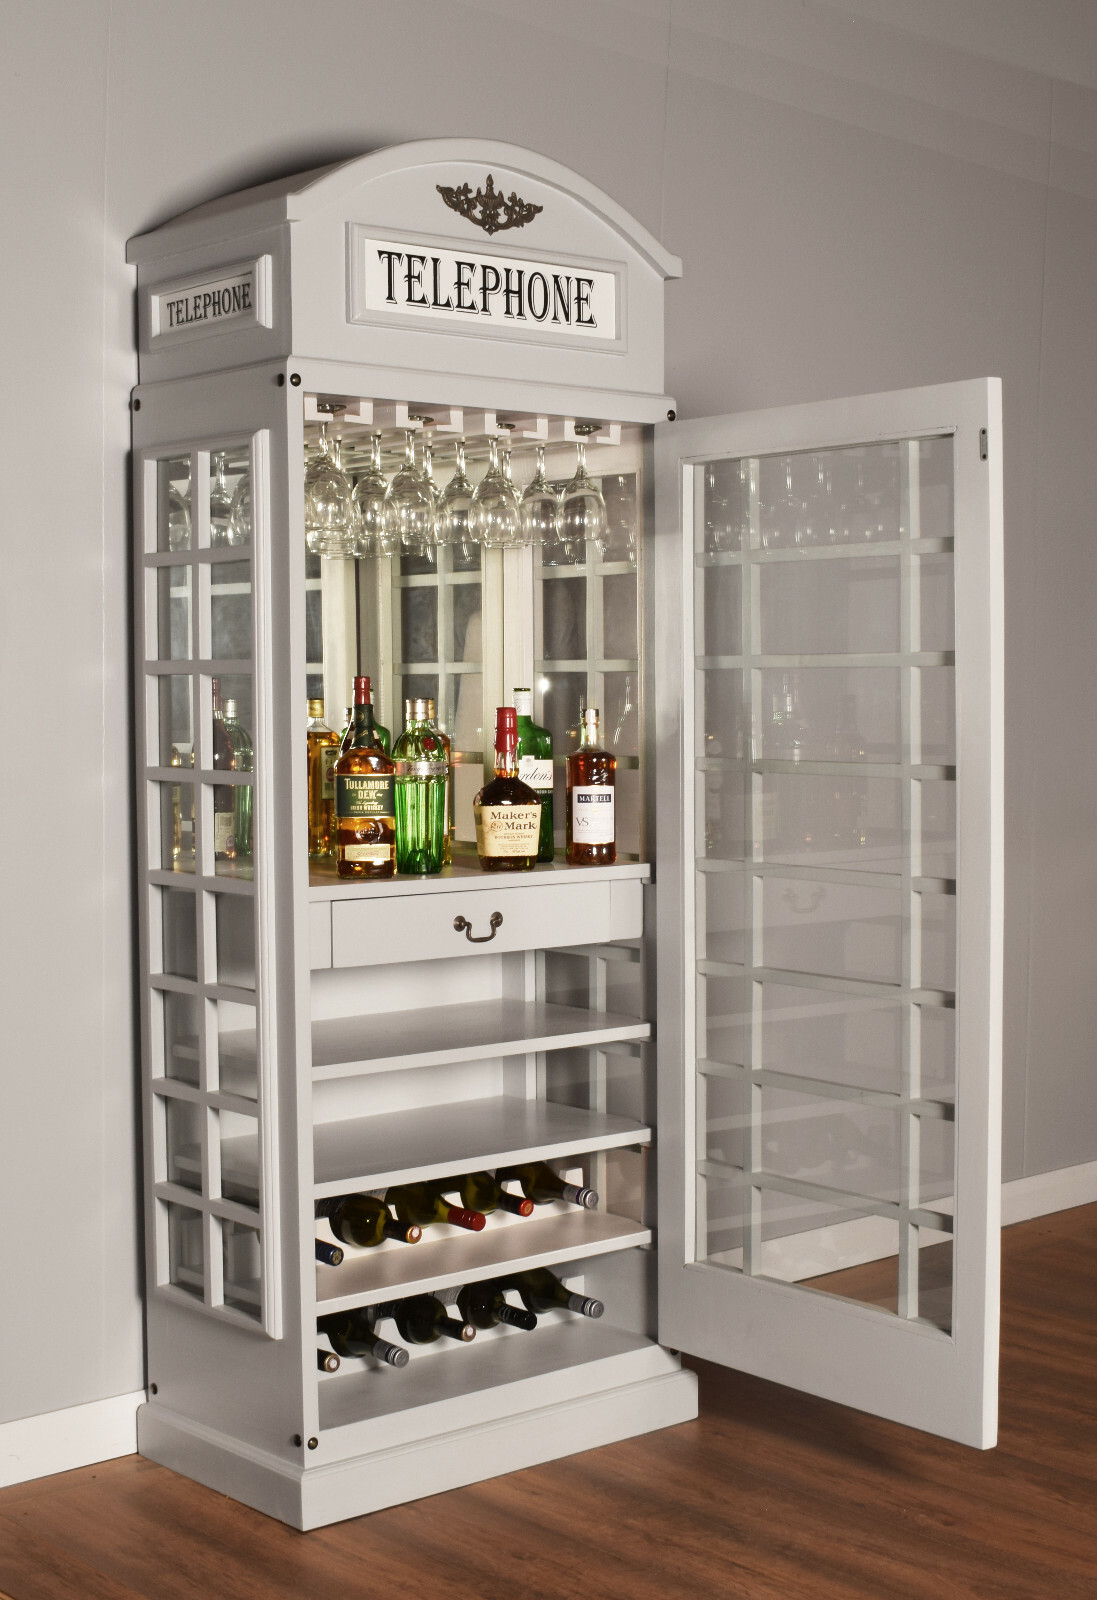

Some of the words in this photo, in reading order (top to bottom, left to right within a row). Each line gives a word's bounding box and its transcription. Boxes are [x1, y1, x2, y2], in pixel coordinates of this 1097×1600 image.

[377, 249, 597, 328] TELEPHONE
[166, 282, 252, 327] TELEPHONE
[519, 767, 553, 781] rdon's
[344, 778, 390, 790] TULLAMORE
[490, 811, 538, 820] Maker's
[504, 821, 537, 830] Mark
[575, 817, 589, 827] VS
